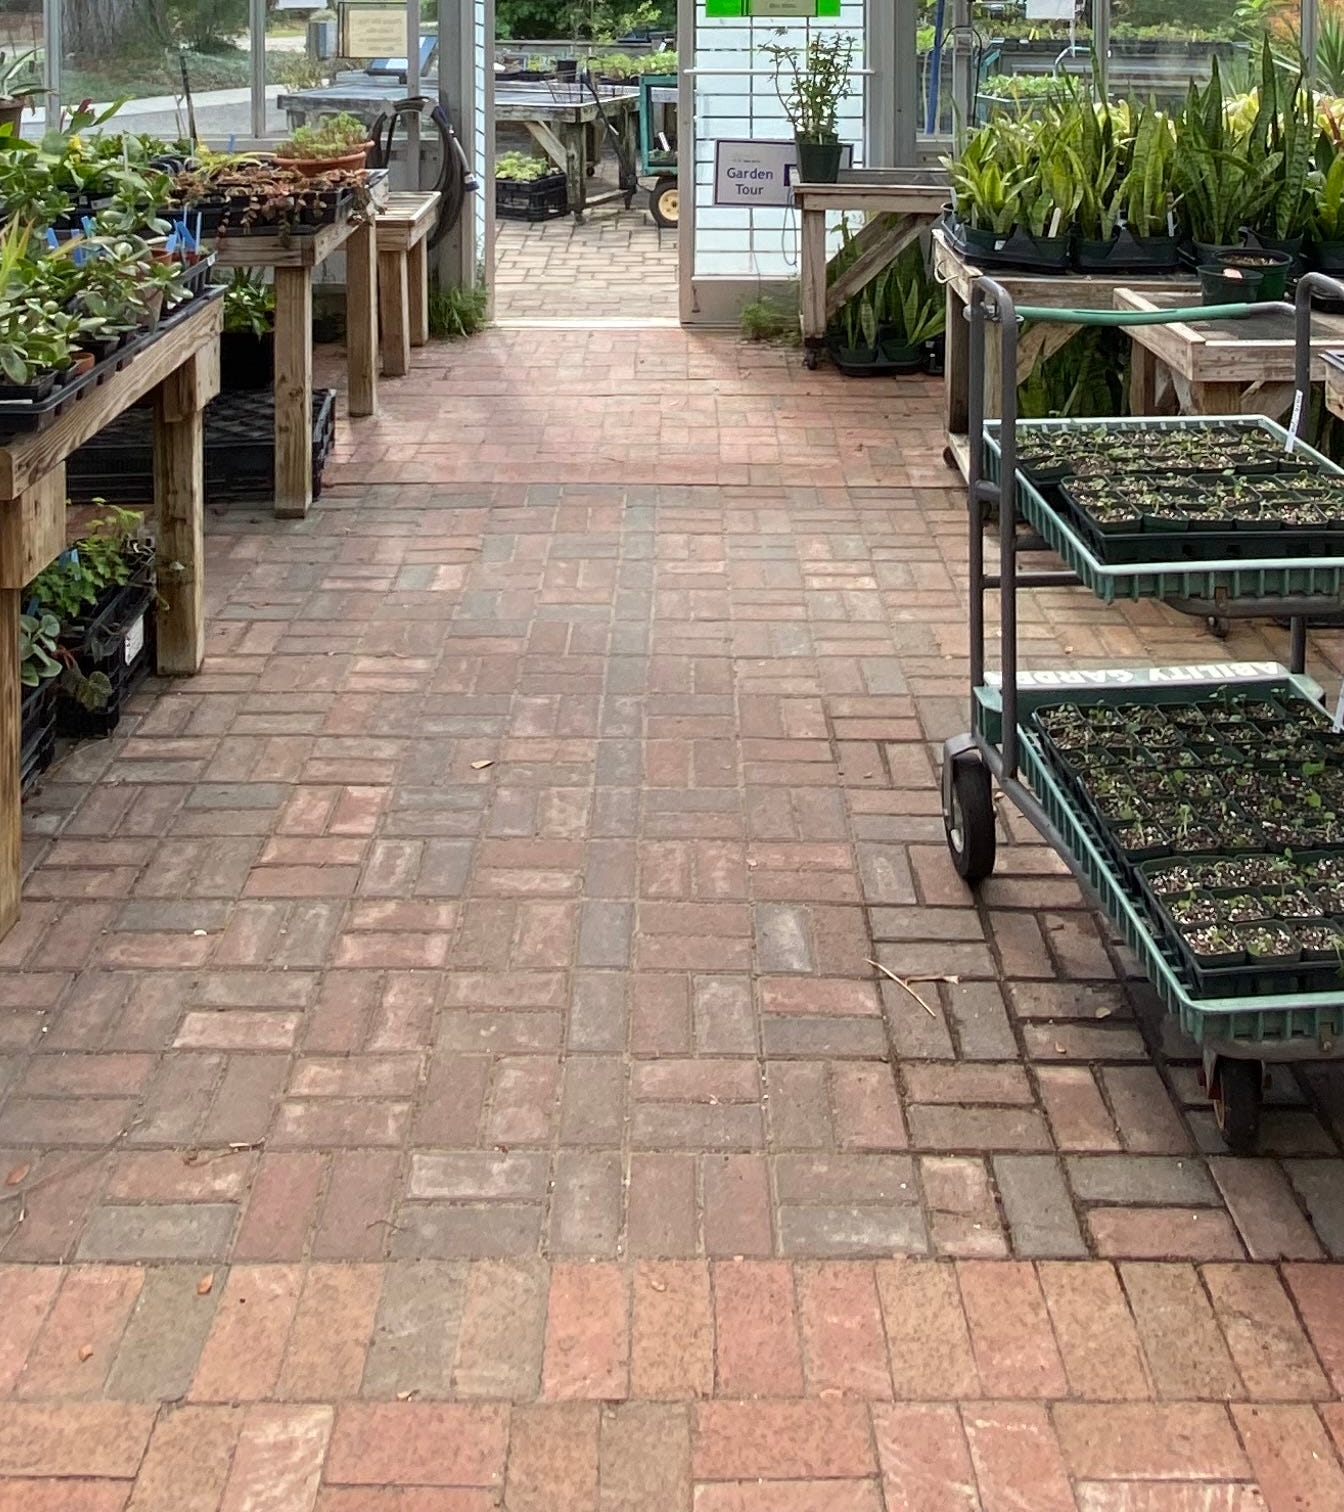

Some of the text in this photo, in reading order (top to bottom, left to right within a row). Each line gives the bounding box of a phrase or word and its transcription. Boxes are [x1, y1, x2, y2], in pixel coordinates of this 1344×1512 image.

[726, 167, 774, 180] Garden
[735, 183, 765, 196] Tour
[1148, 661, 1279, 682] ABILITY
